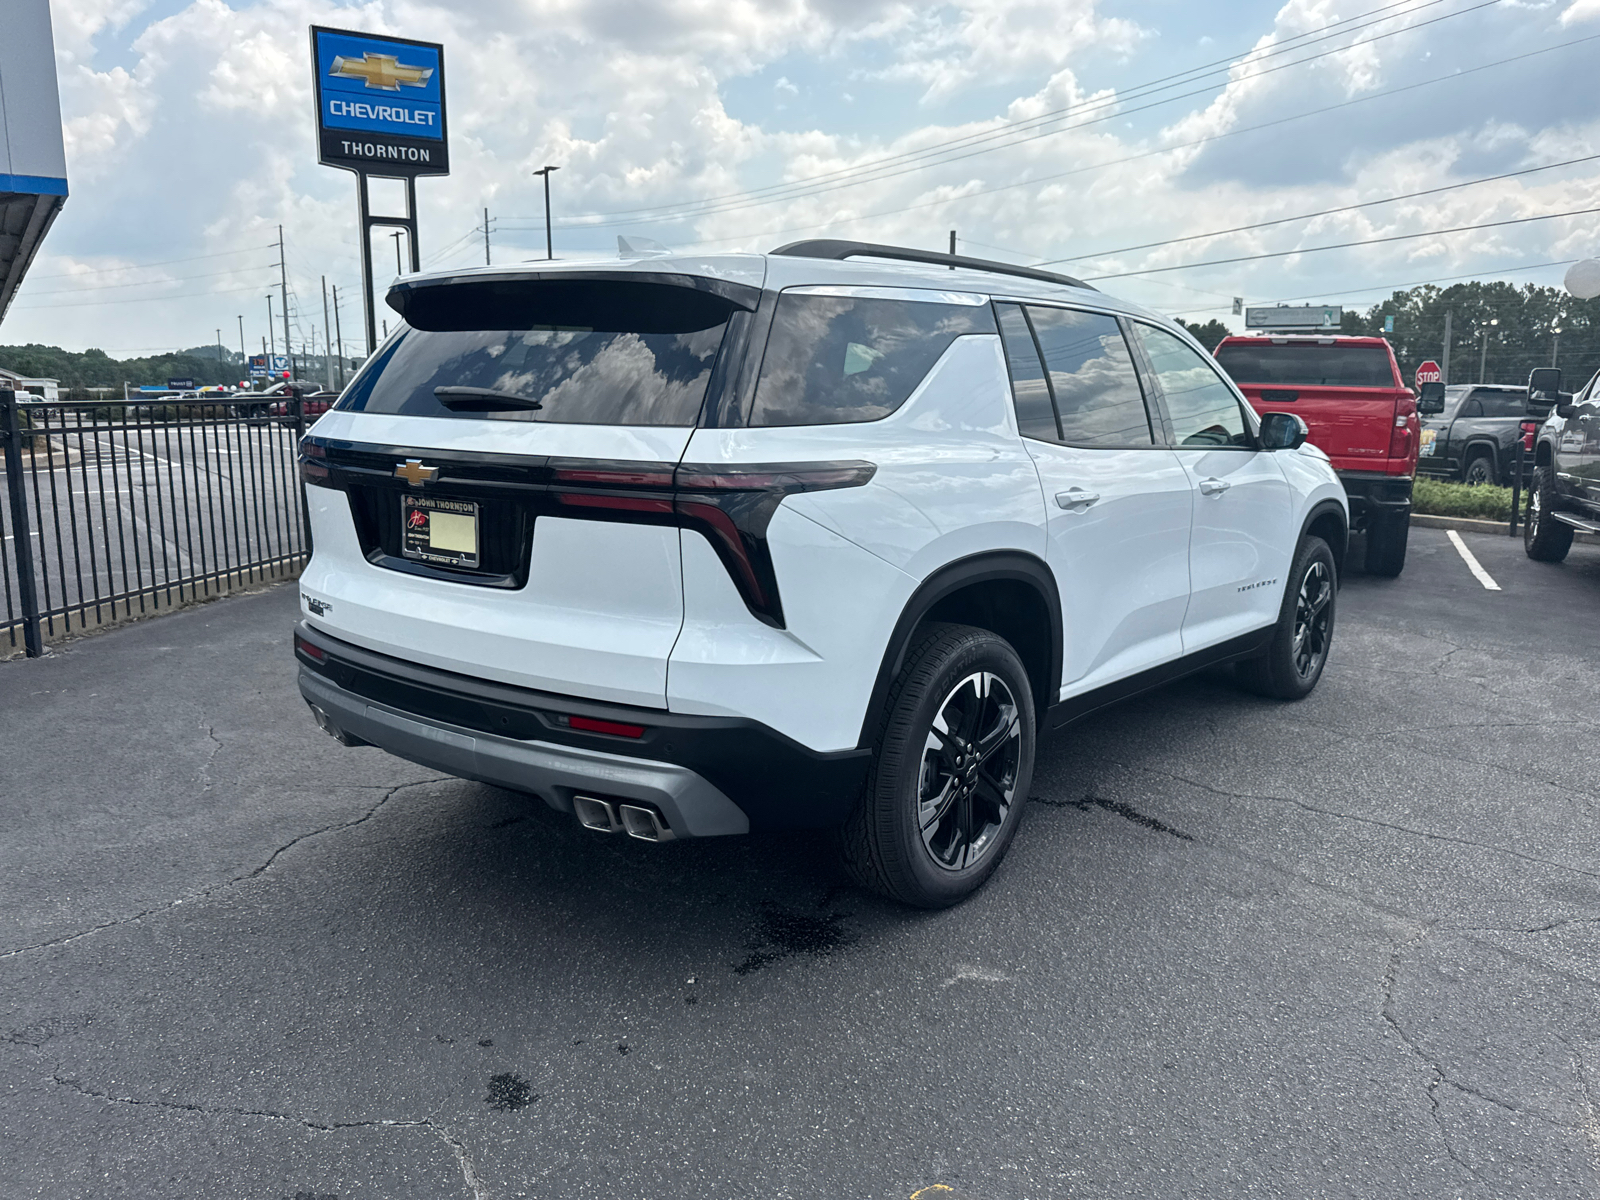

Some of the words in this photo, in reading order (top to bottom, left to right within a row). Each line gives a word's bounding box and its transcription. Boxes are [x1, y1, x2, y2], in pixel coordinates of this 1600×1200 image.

[330, 100, 435, 126] CHEVROLET
[341, 141, 430, 162] THORNTON
[1417, 371, 1440, 386] STOP
[418, 498, 436, 508] JOHN
[436, 500, 474, 512] THORNTON
[1237, 578, 1277, 593] TRAVERSE
